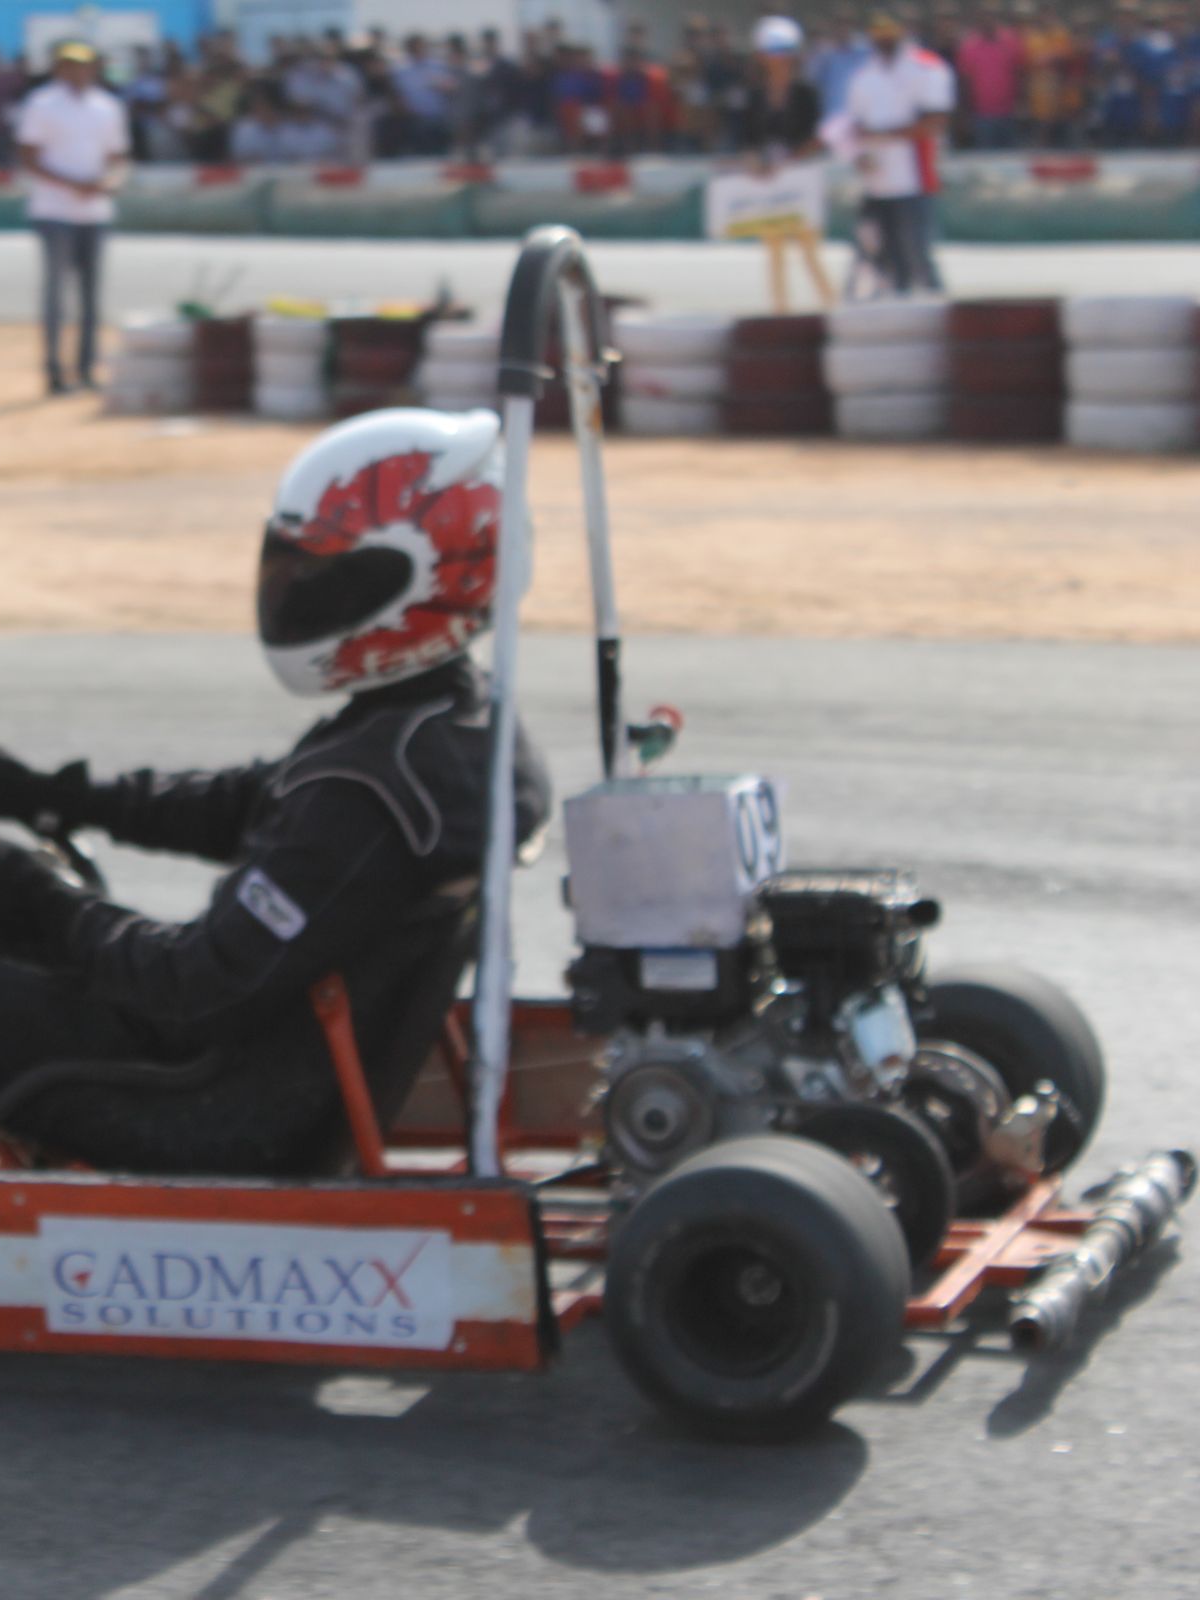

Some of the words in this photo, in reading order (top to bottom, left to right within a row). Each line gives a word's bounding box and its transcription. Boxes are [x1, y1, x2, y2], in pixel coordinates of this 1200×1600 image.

[735, 780, 782, 881] 09
[52, 1236, 431, 1309] CADMAXX
[61, 1302, 417, 1338] SOLUTIONS
